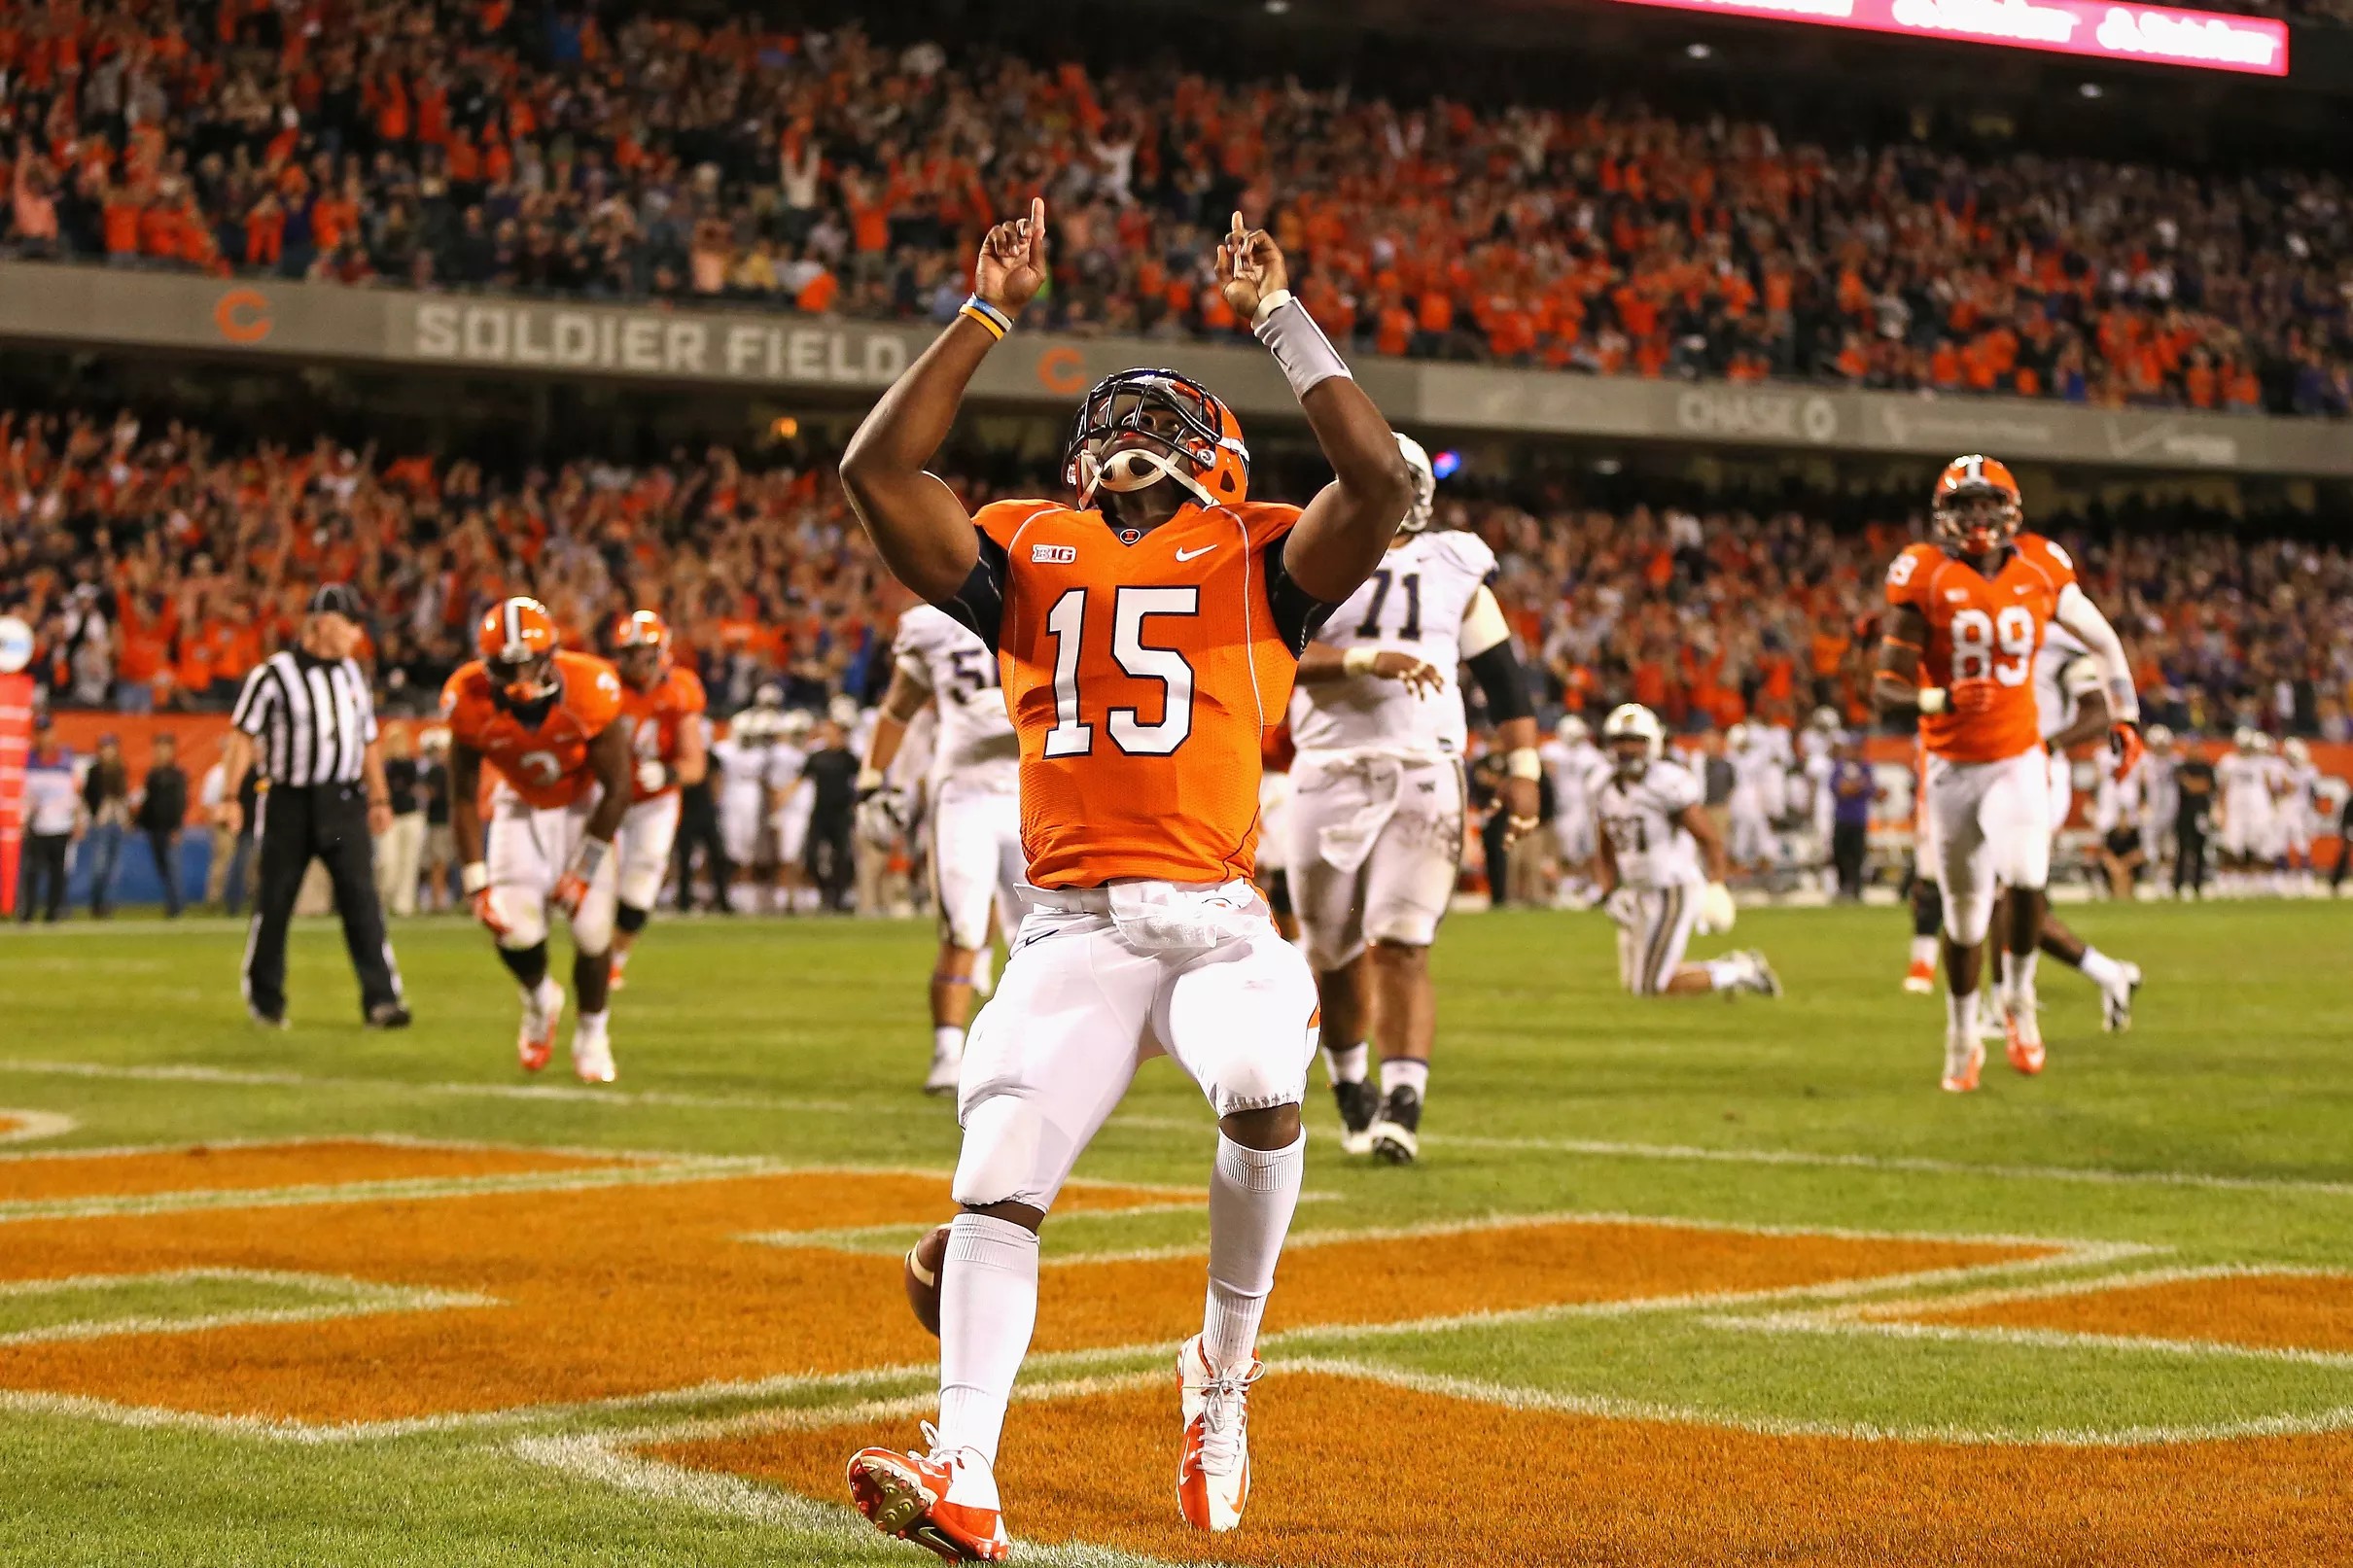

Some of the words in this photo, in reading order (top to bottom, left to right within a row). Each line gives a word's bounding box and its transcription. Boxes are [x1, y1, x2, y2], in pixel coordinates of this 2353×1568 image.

[214, 289, 273, 343] C
[415, 302, 709, 373] SOLDIER
[723, 325, 908, 380] FIELD
[1037, 345, 1087, 395] C
[1354, 568, 1421, 641] 71
[950, 648, 1001, 706] 5
[1042, 585, 1200, 759] 15
[1949, 606, 2035, 687] 89
